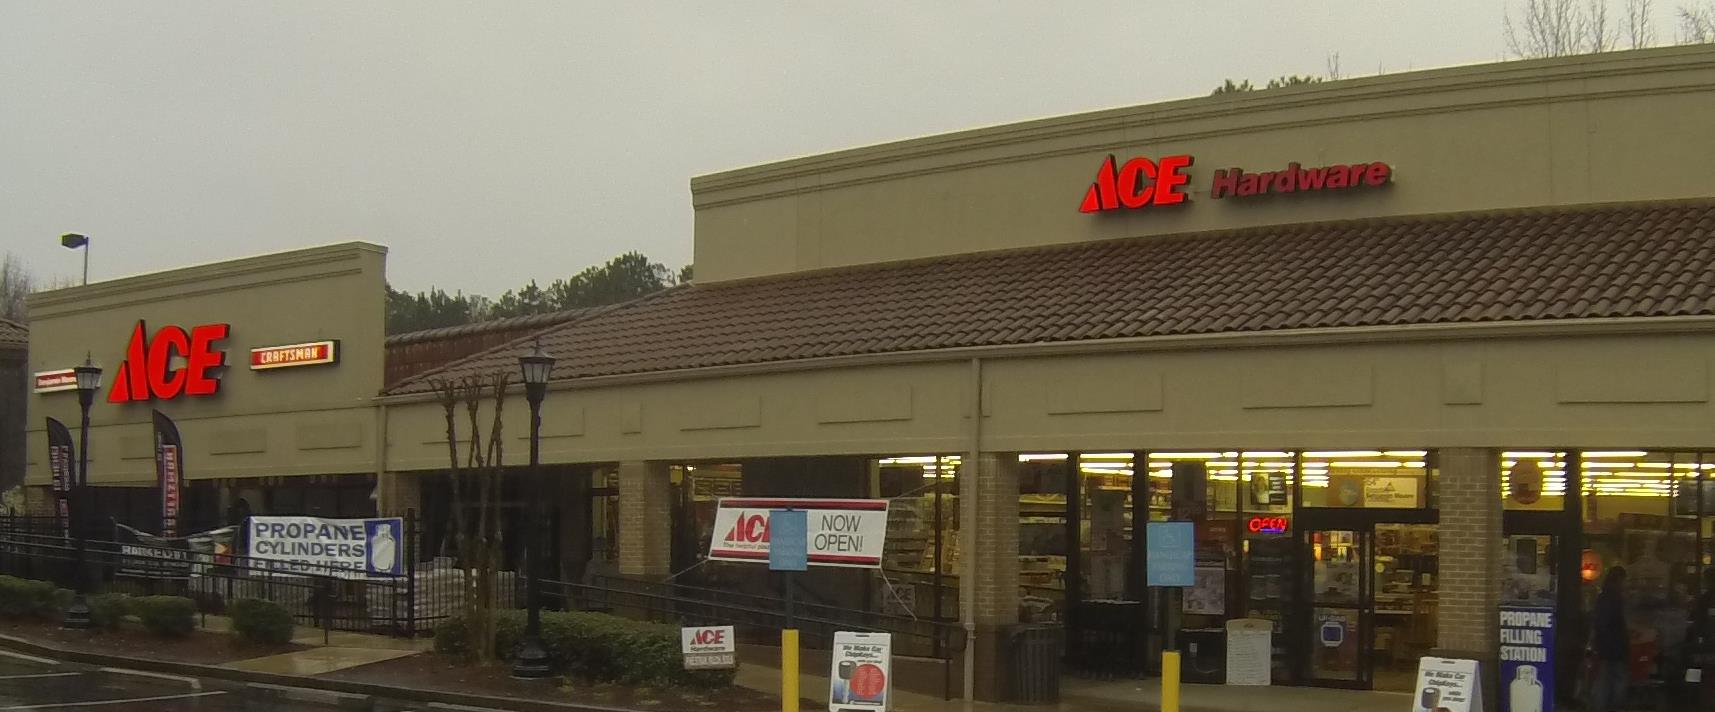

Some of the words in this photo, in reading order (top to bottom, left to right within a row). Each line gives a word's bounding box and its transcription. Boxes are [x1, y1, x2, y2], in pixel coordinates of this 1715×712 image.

[1078, 154, 1194, 213] ACE
[1211, 161, 1391, 199] Hardware
[107, 319, 230, 403] ACE
[260, 345, 318, 364] CRAFTSMAN
[255, 522, 366, 541] PROPANE
[821, 514, 862, 532] NOW
[1249, 516, 1288, 533] OPEN
[255, 540, 365, 559] CYLINDERS
[814, 533, 864, 553] OPEN!
[1499, 611, 1553, 628] PROPANE
[689, 628, 726, 646] ACE
[1501, 628, 1543, 644] FILLING
[1501, 645, 1547, 662] STATION
